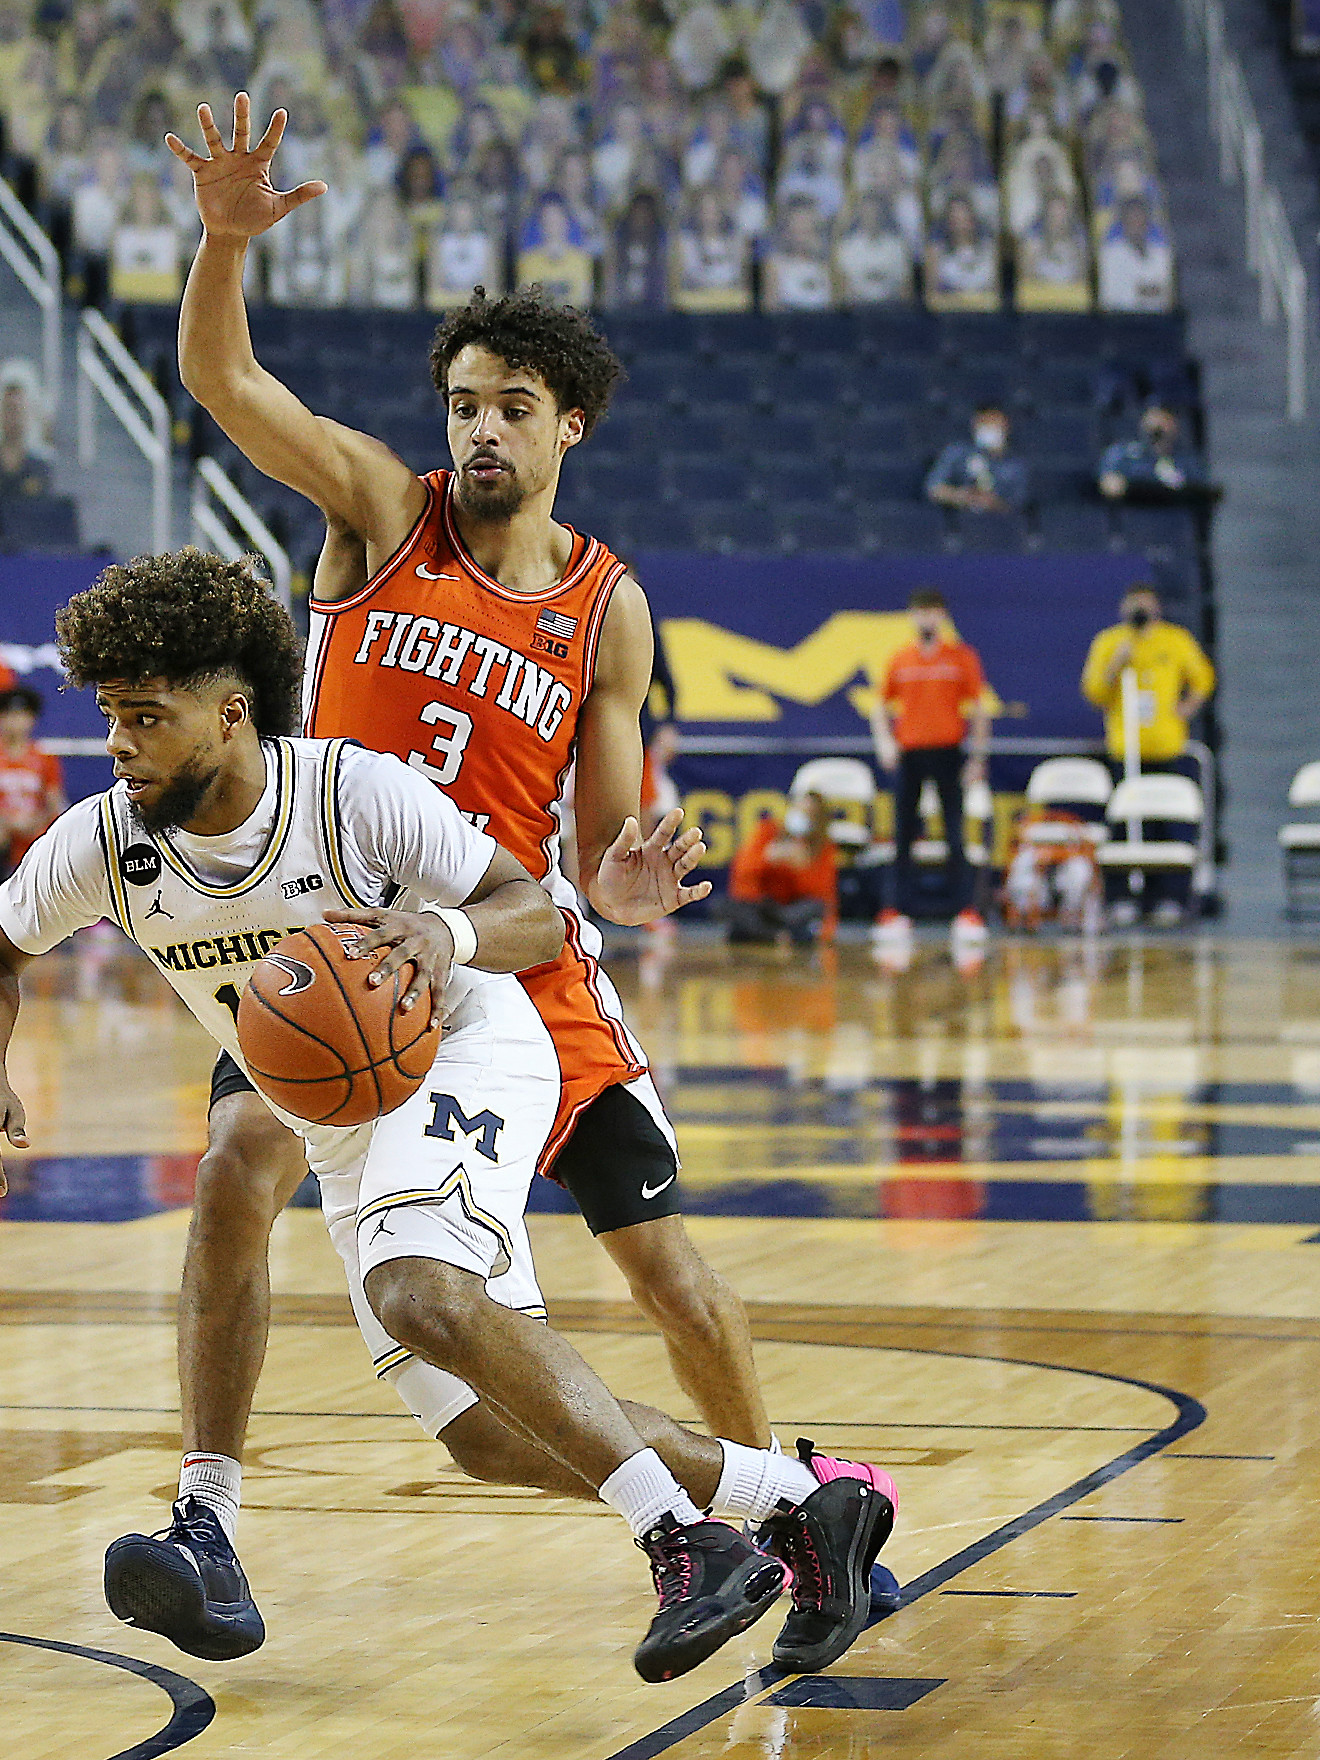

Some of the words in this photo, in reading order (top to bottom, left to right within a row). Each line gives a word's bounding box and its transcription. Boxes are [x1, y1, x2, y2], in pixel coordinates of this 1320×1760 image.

[354, 609, 572, 742] FIGHTING
[407, 700, 474, 787] 3
[125, 856, 157, 872] BLM
[150, 925, 307, 972] MICHIG
[423, 1091, 505, 1163] M
